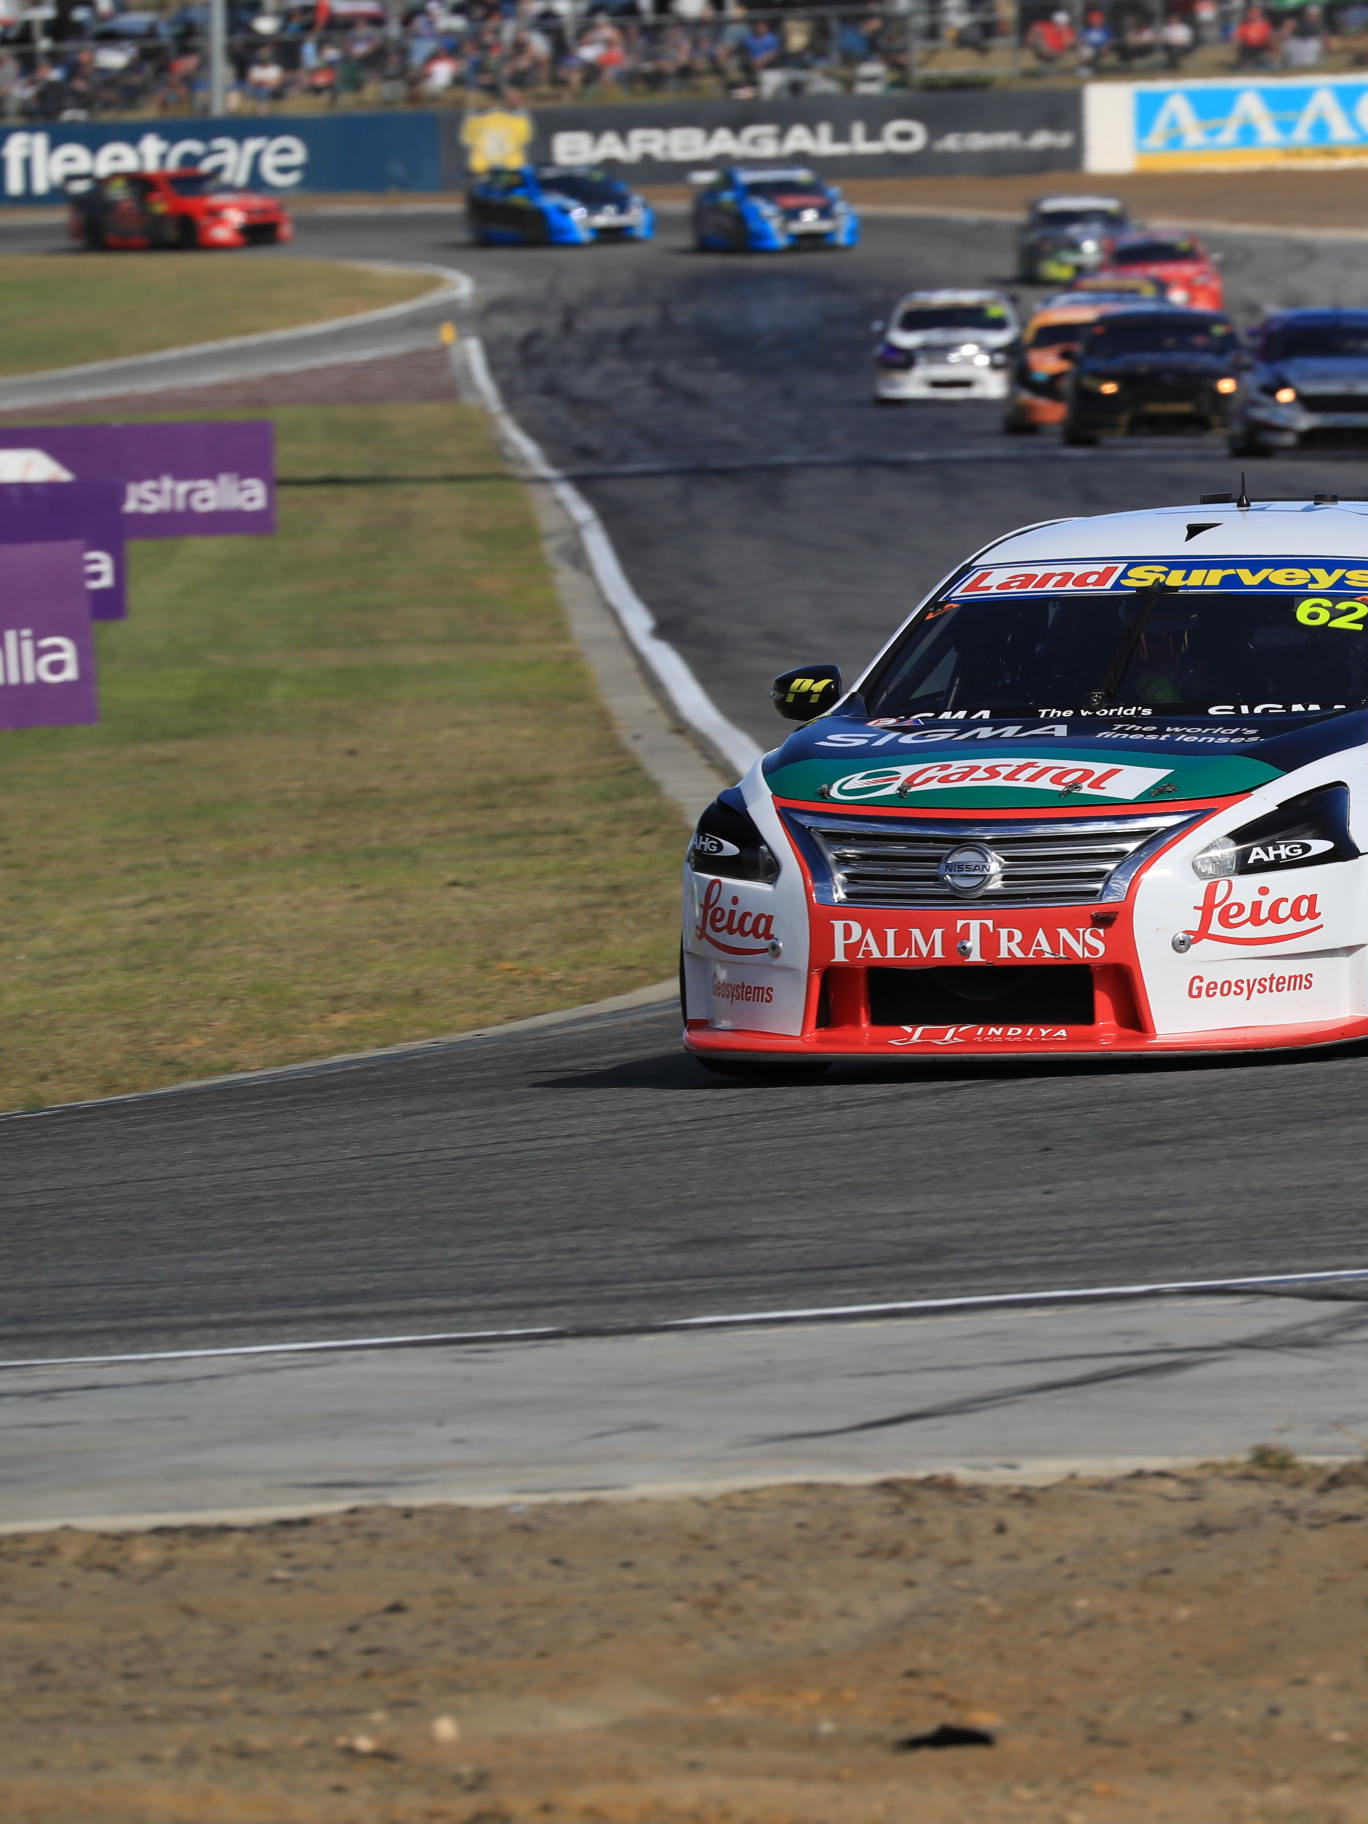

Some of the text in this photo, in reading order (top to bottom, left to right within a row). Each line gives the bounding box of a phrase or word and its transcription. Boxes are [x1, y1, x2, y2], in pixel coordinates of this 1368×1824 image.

[552, 121, 927, 167] BARBAGALLO
[1, 131, 308, 195] fleetcare
[962, 566, 1118, 593] Land
[1296, 597, 1368, 631] 62
[1038, 708, 1074, 718] The
[814, 724, 1068, 748] SIGMA
[1095, 731, 1265, 744] finest lenses.
[1111, 723, 1259, 735] The world's
[902, 761, 1123, 790] Castrol
[944, 862, 991, 874] NISSAN
[1247, 844, 1303, 864] AHG
[696, 878, 775, 953] Leica
[1182, 879, 1324, 946] Leica
[830, 919, 1106, 962] PALM TRANS
[712, 972, 774, 1005] Geosystems
[1187, 972, 1313, 1001] Geosystems
[976, 1026, 1068, 1038] INDIYA
